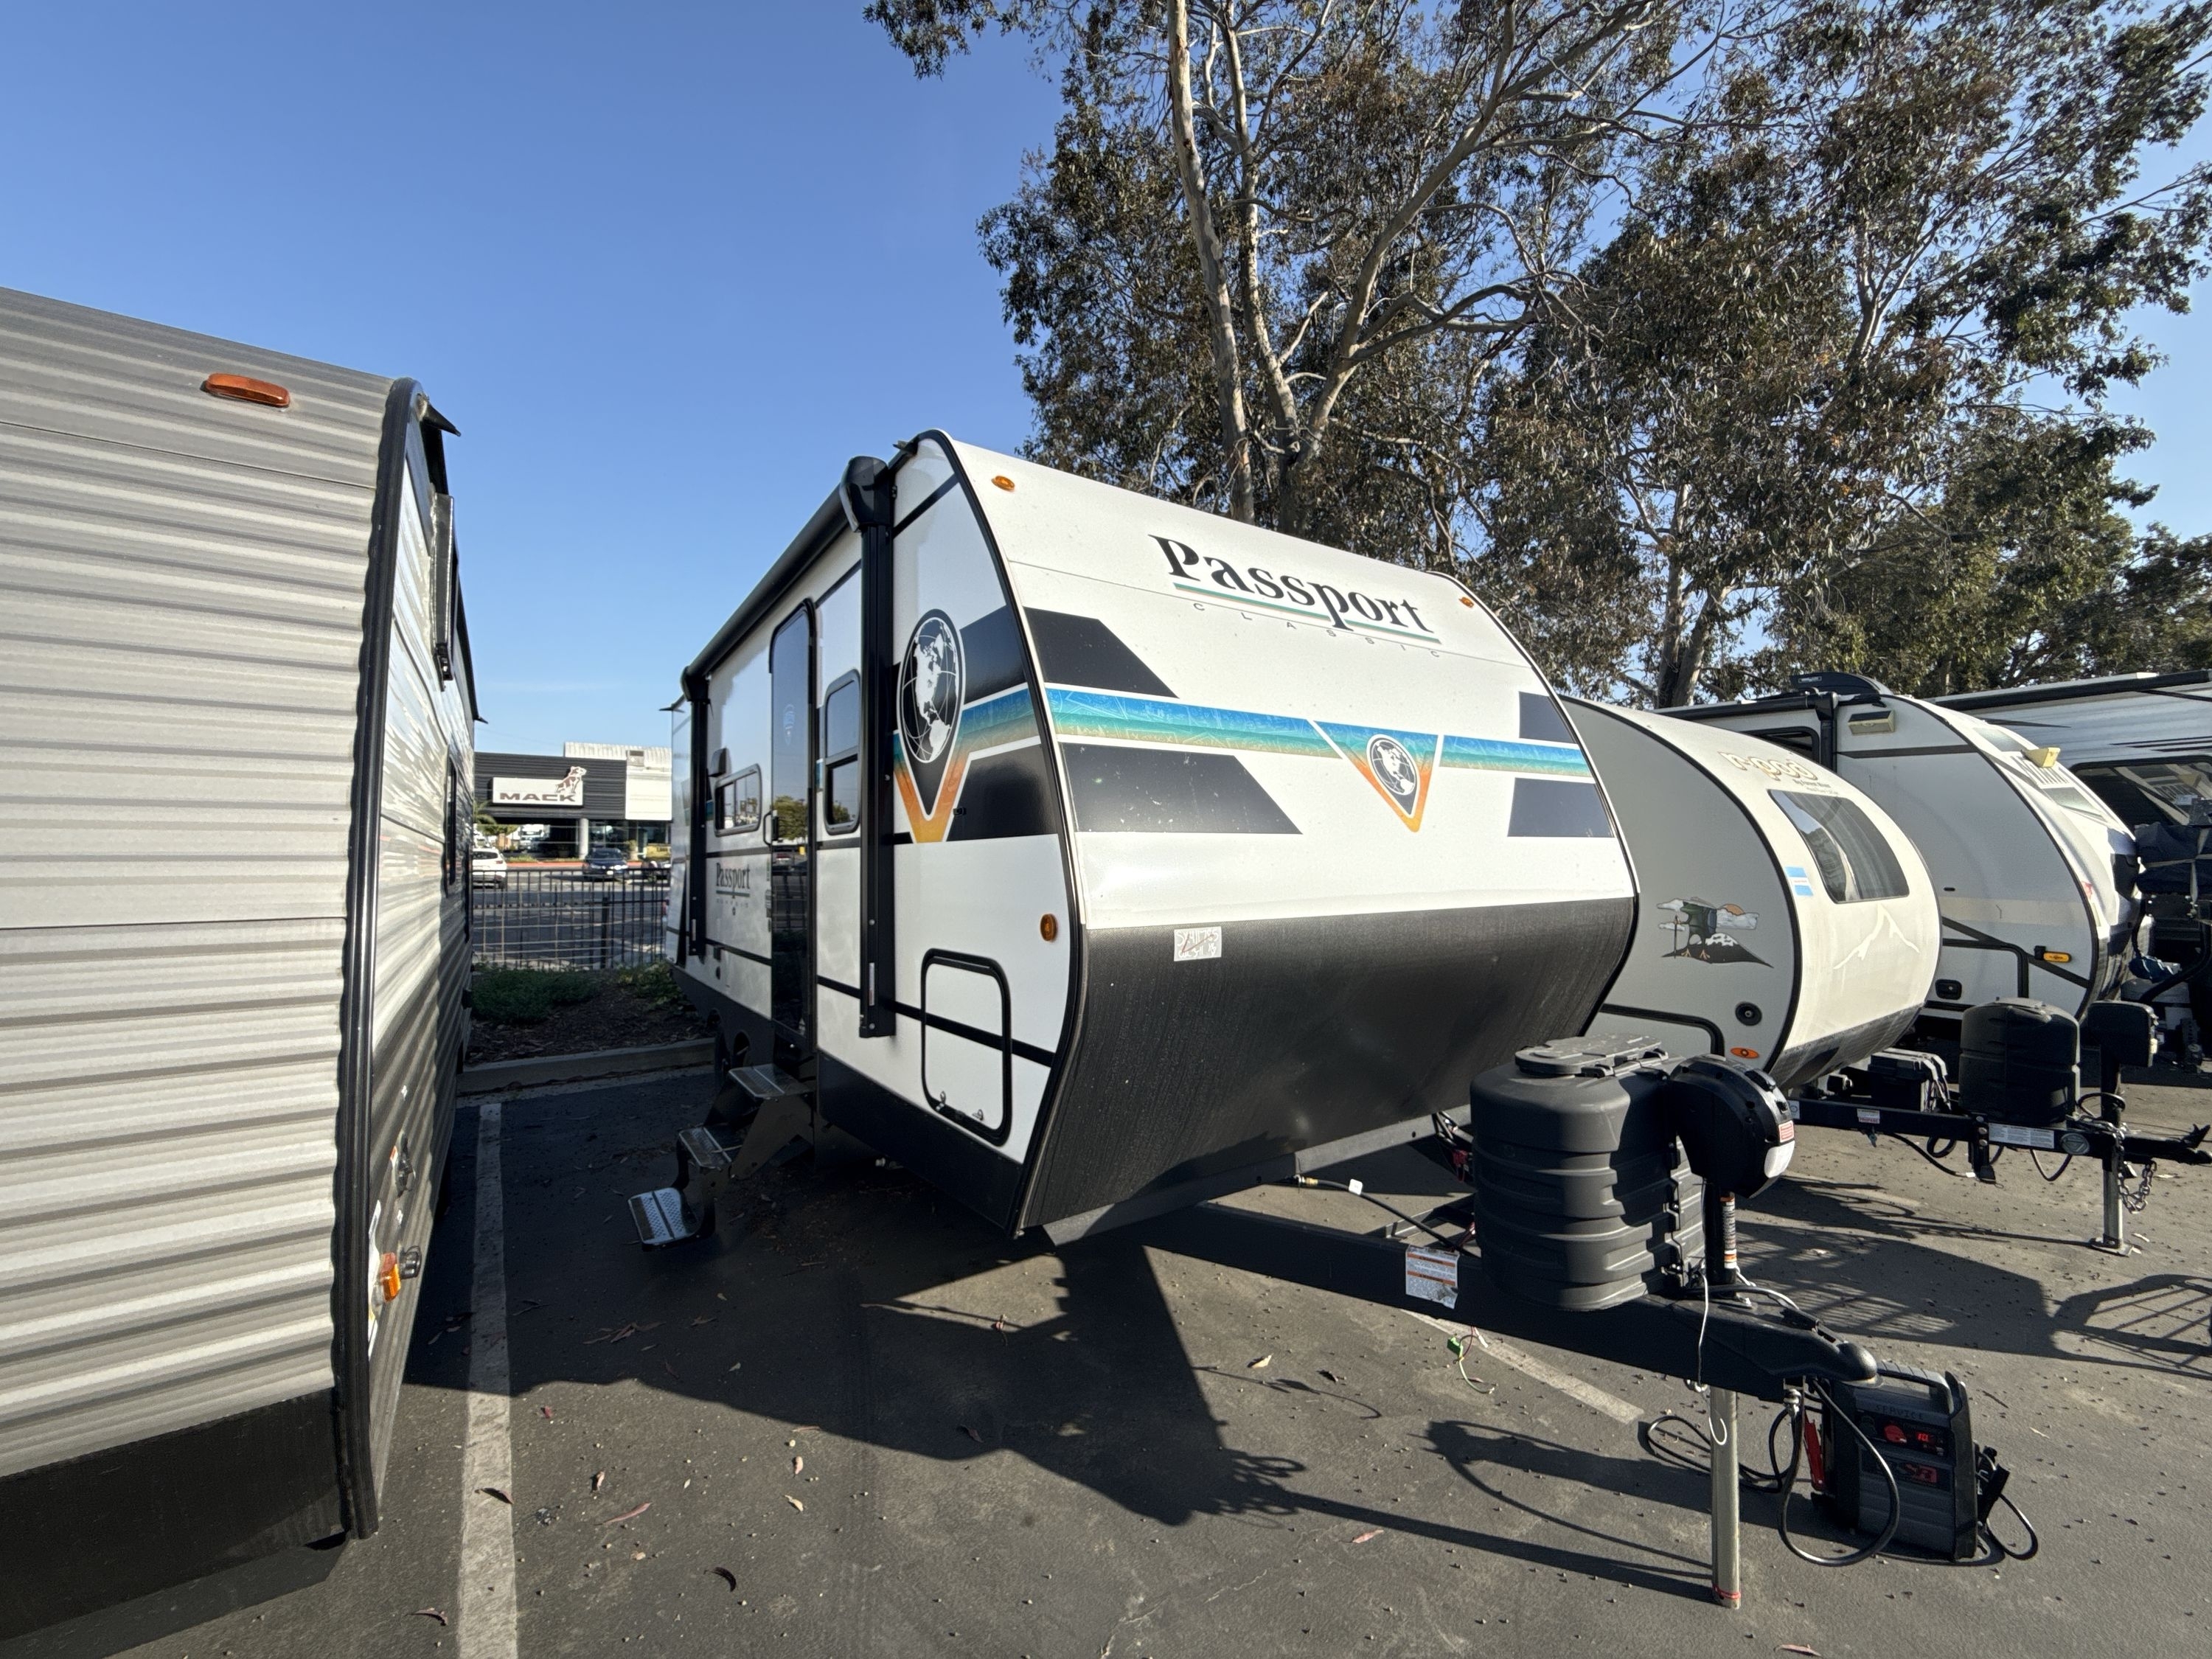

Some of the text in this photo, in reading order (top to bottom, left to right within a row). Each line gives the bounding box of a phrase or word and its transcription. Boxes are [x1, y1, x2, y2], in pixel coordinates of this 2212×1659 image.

[1148, 534, 1434, 632] Passport
[1193, 602, 1441, 658] CLASSIC
[499, 792, 576, 802] MACK
[716, 862, 751, 899] Passport
